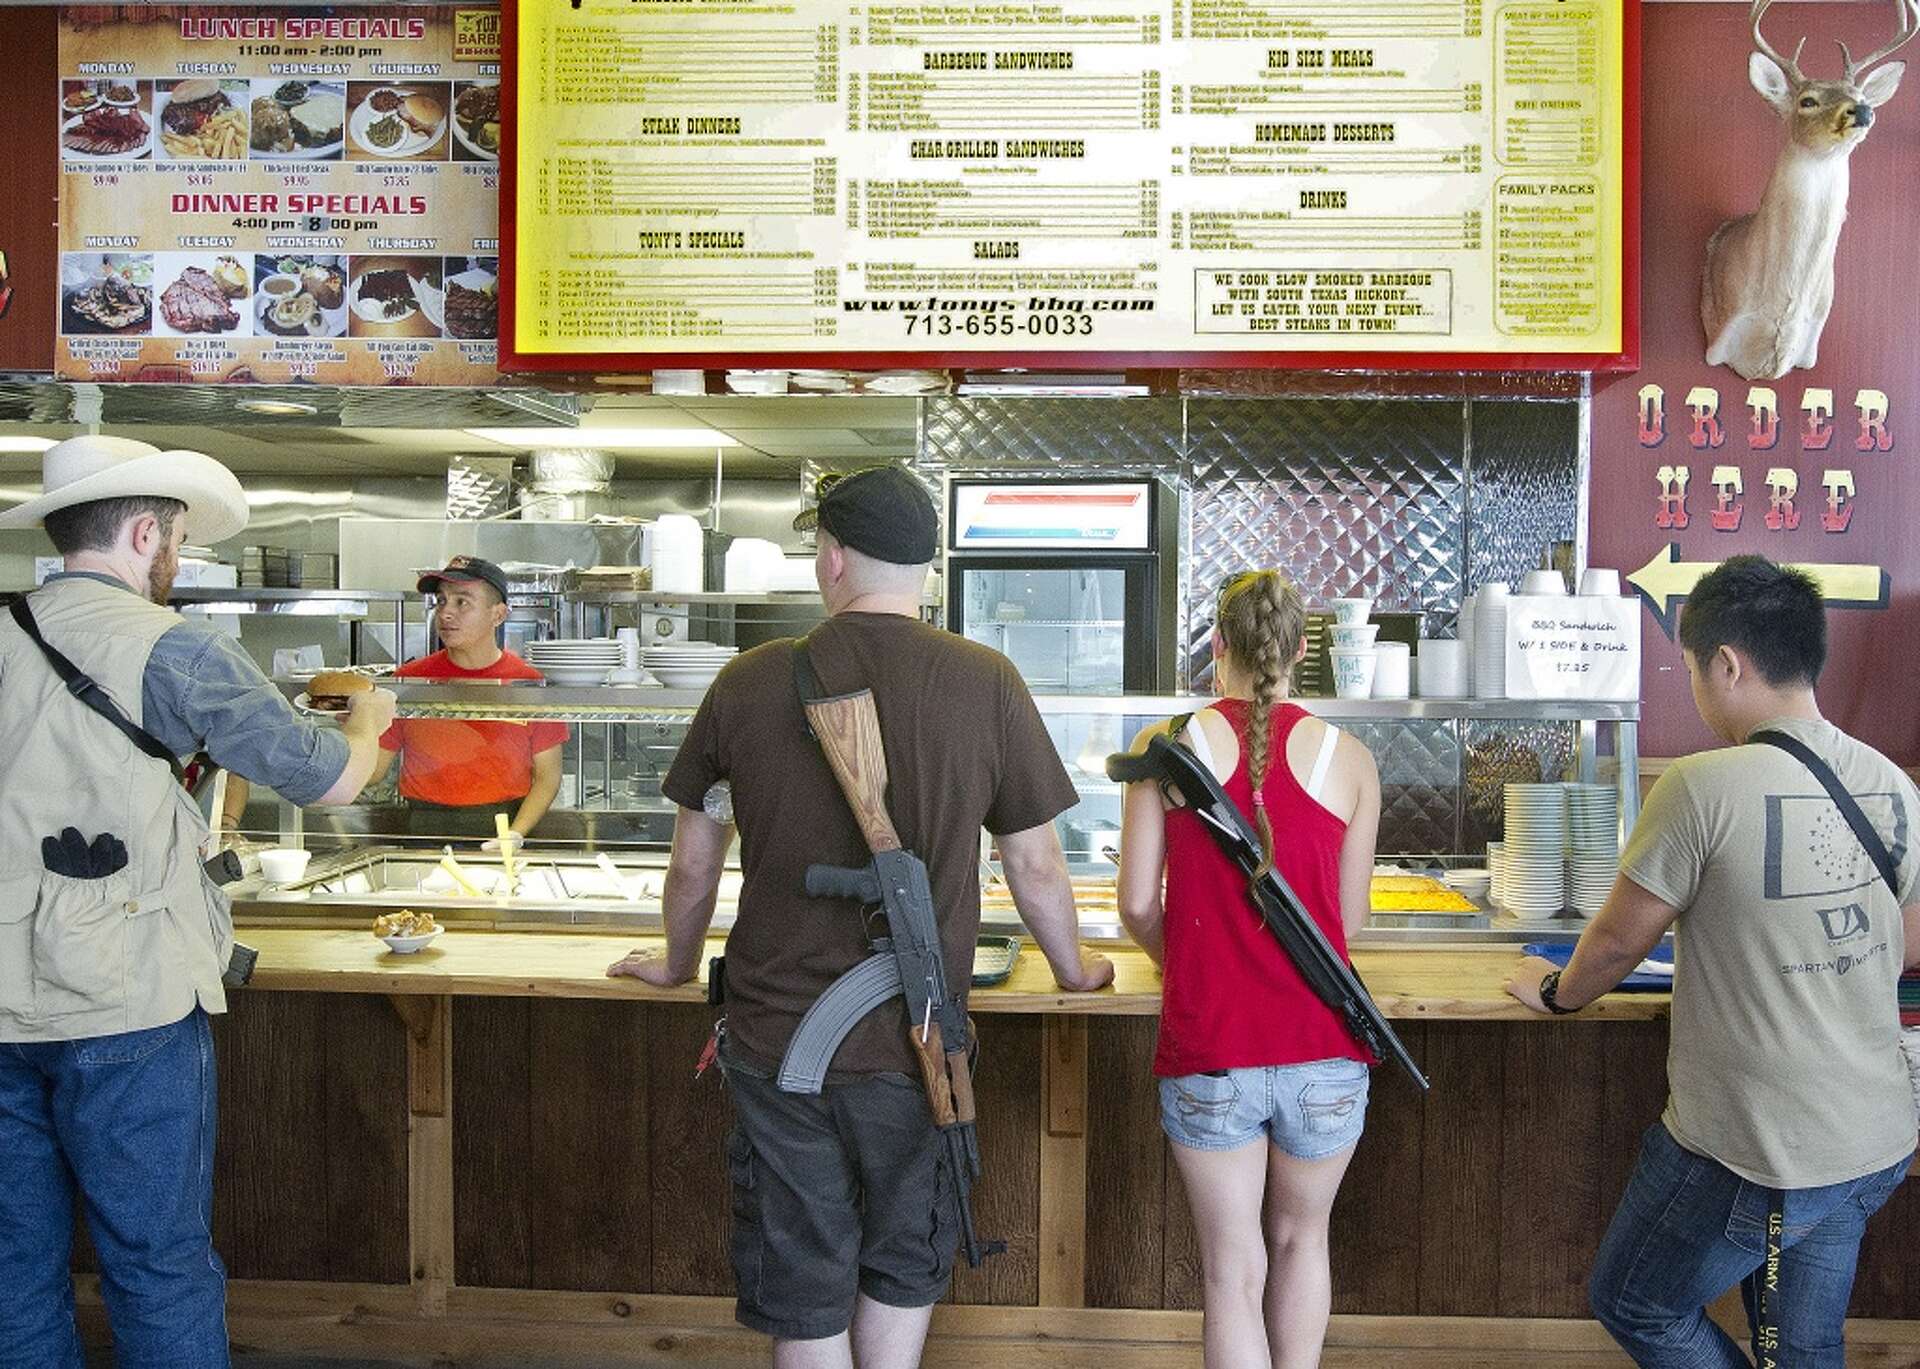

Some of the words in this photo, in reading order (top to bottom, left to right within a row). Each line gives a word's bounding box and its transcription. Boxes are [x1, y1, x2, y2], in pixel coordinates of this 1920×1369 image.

[181, 18, 277, 40] LUNCH
[285, 18, 425, 40] SPECIALS
[238, 45, 280, 56] 11:00
[284, 47, 308, 56] am
[320, 45, 354, 56] 2:00
[358, 47, 382, 58] pm
[1269, 50, 1290, 67] KID
[1297, 50, 1323, 67] SIZE
[1332, 50, 1374, 67] MEALS
[78, 63, 135, 75] MONDAY
[176, 63, 237, 75] TUESDAY
[269, 63, 351, 75] WEDNESDAY
[370, 63, 441, 75] THURSDAY
[924, 52, 987, 70] BARBEQUE
[995, 51, 1073, 69] SANDWICHES
[642, 117, 679, 134] STEAK
[687, 117, 741, 134] DINNERS
[1255, 124, 1326, 141] HOMEMADE
[1334, 124, 1395, 141] DESSERTS
[911, 141, 943, 158] CHAR
[947, 141, 998, 158] GRILLED
[1006, 141, 1084, 158] SANDWICHES
[1499, 184, 1546, 195] FAMILY
[1550, 184, 1594, 195] PACKS
[172, 194, 278, 213] DINNER
[288, 194, 426, 215] SPECIALS
[1300, 191, 1347, 209] DRINKS
[232, 218, 268, 228] 4:00
[271, 220, 295, 231] pm
[354, 221, 378, 231] pm
[85, 236, 140, 248] MONDAY
[178, 236, 237, 248] TUESDAY
[266, 236, 346, 248] WEDNESDAY
[368, 236, 437, 248] THURSDAY
[639, 232, 681, 248] TONY'S
[689, 232, 744, 248] SPECIALS
[974, 241, 1019, 259] SALADS
[1214, 274, 1232, 285] WE
[1239, 274, 1268, 285] COOK
[1276, 274, 1307, 285] SLOW
[1315, 274, 1364, 285] SMOKED
[1371, 274, 1431, 285] BARBEQUE
[1228, 289, 1259, 300] WITH
[1267, 289, 1303, 300] SOUTH
[1310, 289, 1347, 300] TEXAS
[1355, 289, 1419, 300] HICKORY...
[1212, 304, 1234, 315] LET
[1241, 304, 1255, 315] US
[1263, 304, 1300, 315] CATER
[1308, 304, 1338, 315] YOUR
[1346, 304, 1376, 315] NEXT
[1385, 304, 1434, 315] EVENT...
[903, 314, 1093, 336] 713-655-0033
[1250, 319, 1278, 330] BEST
[1286, 319, 1330, 330] STEAKS
[1338, 319, 1350, 330] IN
[1360, 319, 1396, 330] TOWN!
[1637, 383, 1894, 452] ORDER
[1656, 465, 1856, 532] HERE
[1531, 620, 1556, 631] BBQ
[1559, 620, 1617, 631] Sandwich
[1550, 640, 1578, 652] SIDE
[1580, 640, 1589, 652] &
[1593, 640, 1629, 652] Drink
[1782, 960, 1836, 974] SPARTAN
[1768, 1212, 1782, 1239] U.S.
[1766, 1244, 1781, 1292] ARMY
